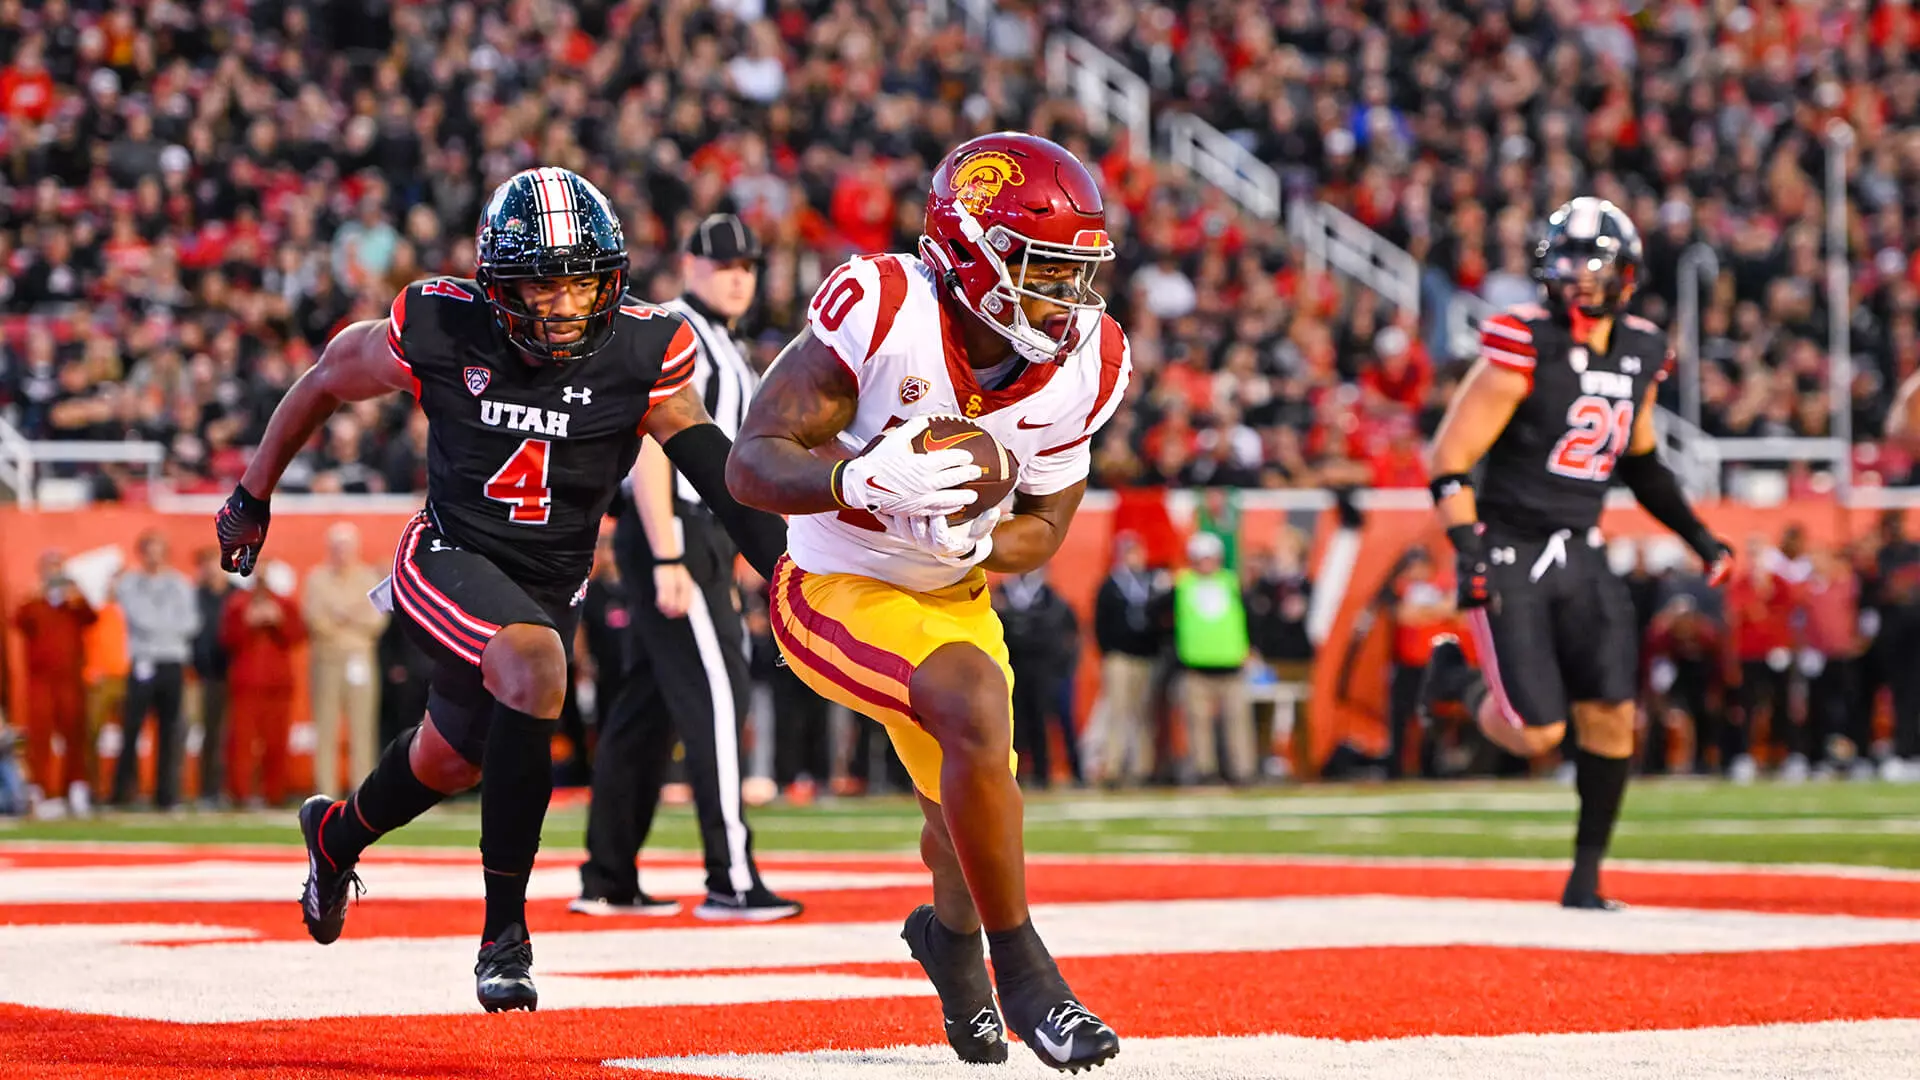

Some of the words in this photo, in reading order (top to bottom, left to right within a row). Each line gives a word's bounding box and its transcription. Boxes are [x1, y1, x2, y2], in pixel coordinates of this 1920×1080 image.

[422, 281, 472, 302] 4
[812, 264, 864, 332] 10
[470, 379, 482, 390] 12
[903, 388, 919, 401] 12
[480, 400, 570, 438] UTAH
[1547, 395, 1634, 481] 21
[484, 439, 551, 525] 4
